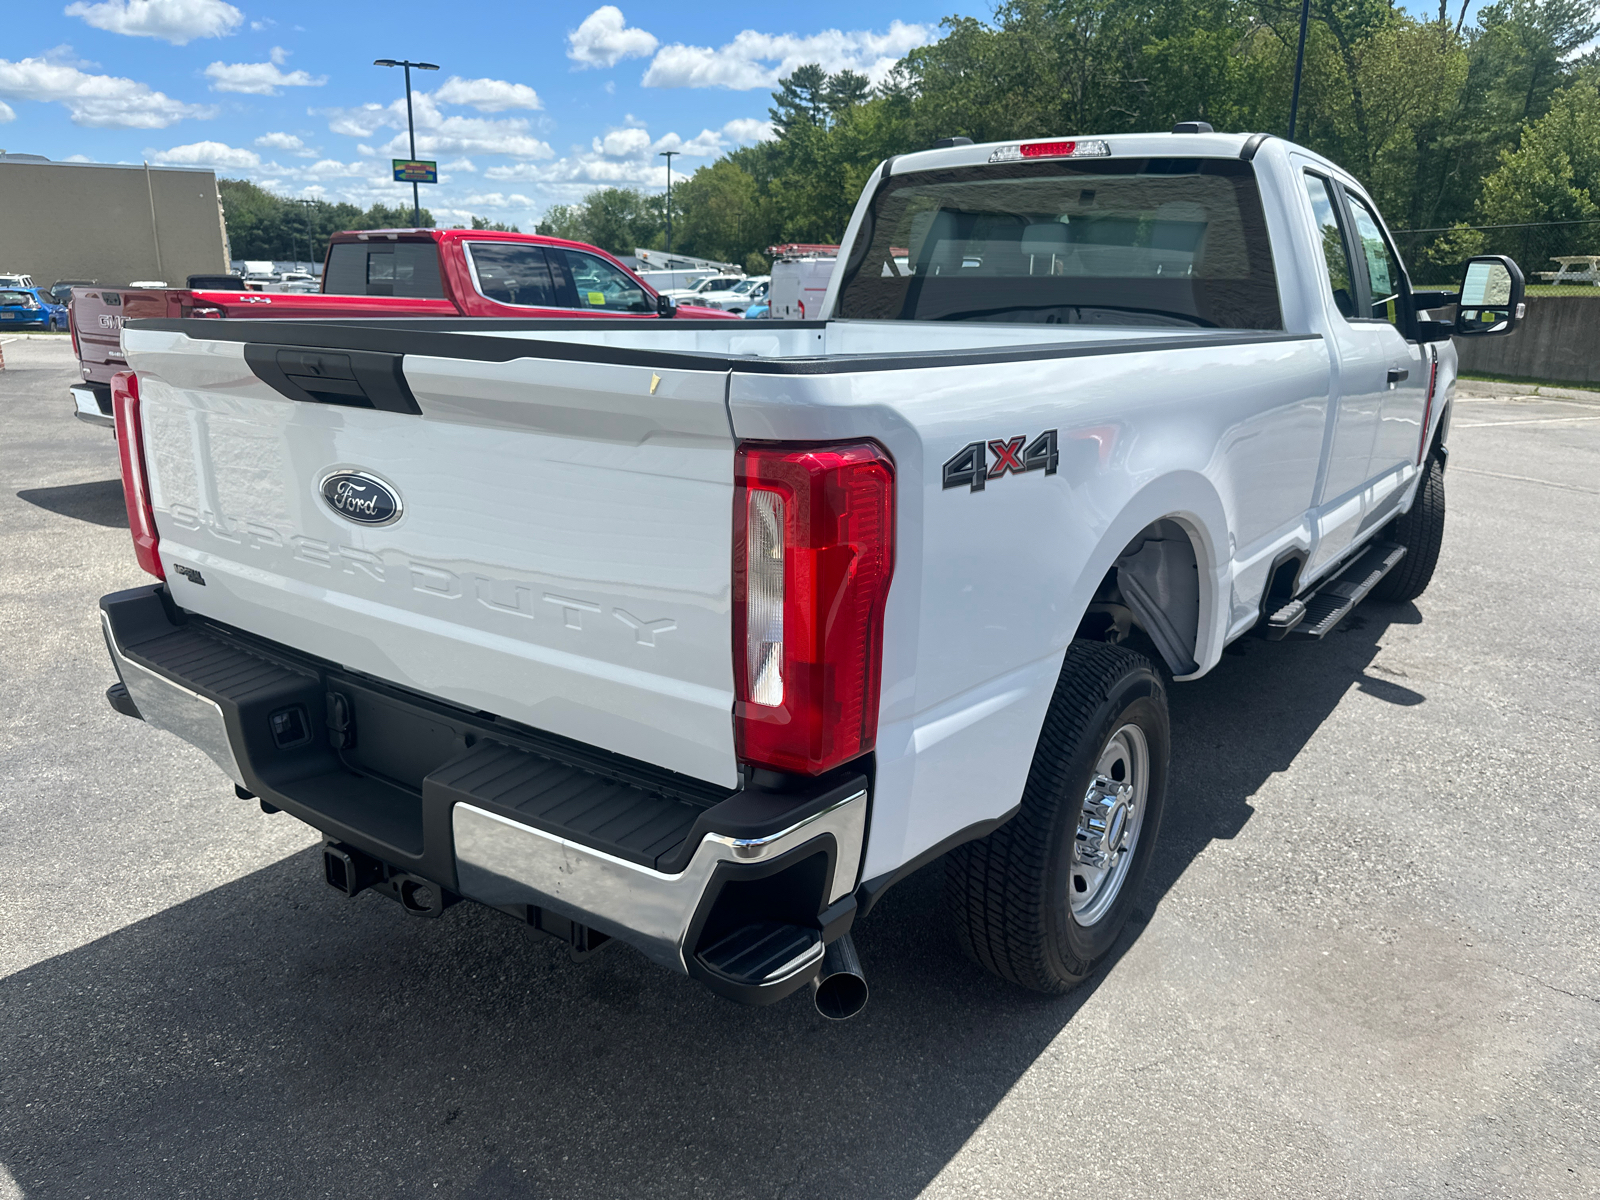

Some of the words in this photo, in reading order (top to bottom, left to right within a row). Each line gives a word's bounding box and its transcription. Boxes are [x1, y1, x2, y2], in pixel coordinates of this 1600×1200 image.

[334, 480, 378, 516] Ford
[169, 502, 387, 583] SUPER
[409, 561, 678, 648] DUTY
